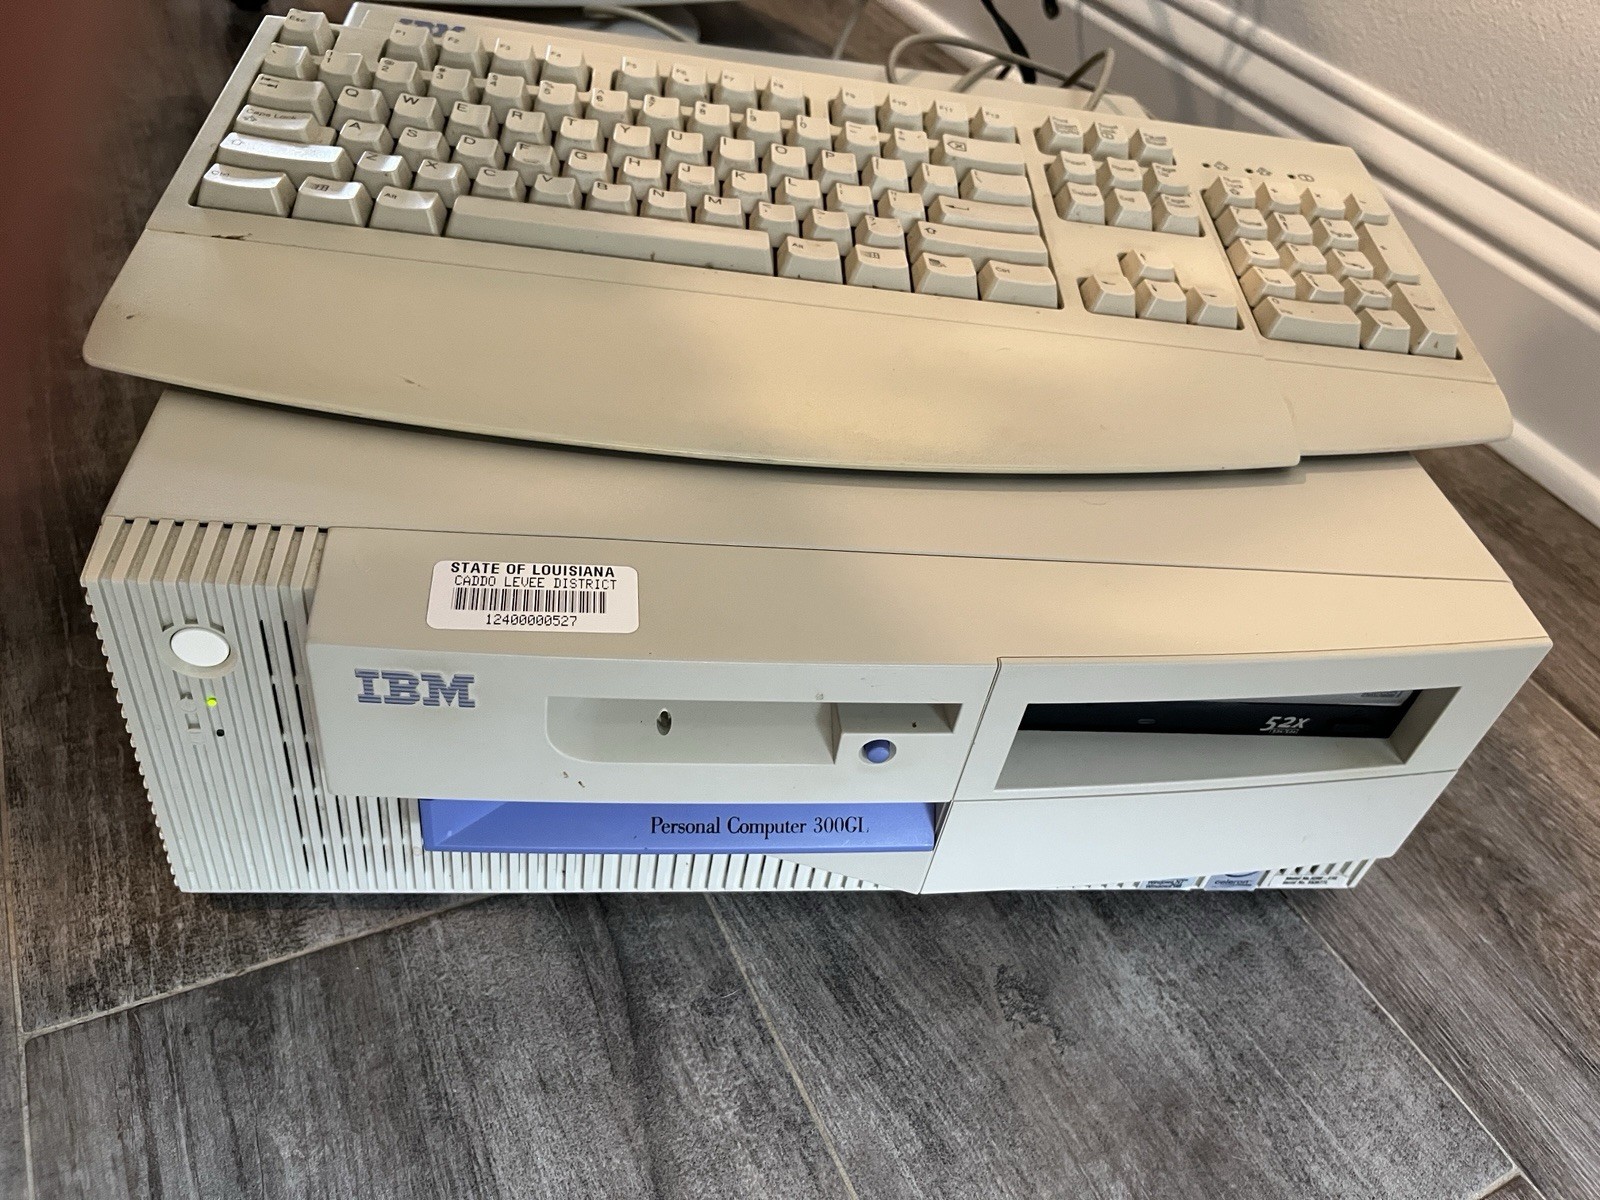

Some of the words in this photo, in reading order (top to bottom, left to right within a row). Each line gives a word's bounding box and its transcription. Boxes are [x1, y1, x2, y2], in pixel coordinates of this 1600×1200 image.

[345, 86, 359, 98] Q
[403, 94, 420, 105] W
[456, 102, 468, 112] E
[245, 107, 272, 118] Caps
[273, 112, 297, 121] Lock
[511, 110, 523, 120] R
[348, 121, 362, 131] A
[567, 118, 577, 126] T
[406, 129, 418, 138] S
[620, 125, 630, 134] Y
[463, 136, 476, 146] D
[671, 131, 682, 141] U
[775, 145, 787, 155] O
[366, 153, 377, 161] Z
[574, 151, 588, 160] G
[628, 157, 640, 167] H
[483, 168, 496, 177] C
[735, 171, 747, 181] K
[542, 174, 553, 182] V
[788, 178, 797, 187] L
[597, 182, 608, 190] B
[653, 189, 665, 198] N
[708, 197, 722, 205] M
[451, 561, 500, 575] STATE
[506, 563, 526, 575] OF
[532, 564, 615, 578] LOUISIANA
[454, 575, 496, 587] CADDO
[504, 576, 545, 588] LEVEE
[554, 578, 618, 590] DISTRICT
[486, 613, 578, 627] 12400000527
[354, 668, 476, 708] IBM
[651, 816, 720, 834] Personal
[727, 816, 807, 839] Computer
[813, 816, 869, 833] 300GL
